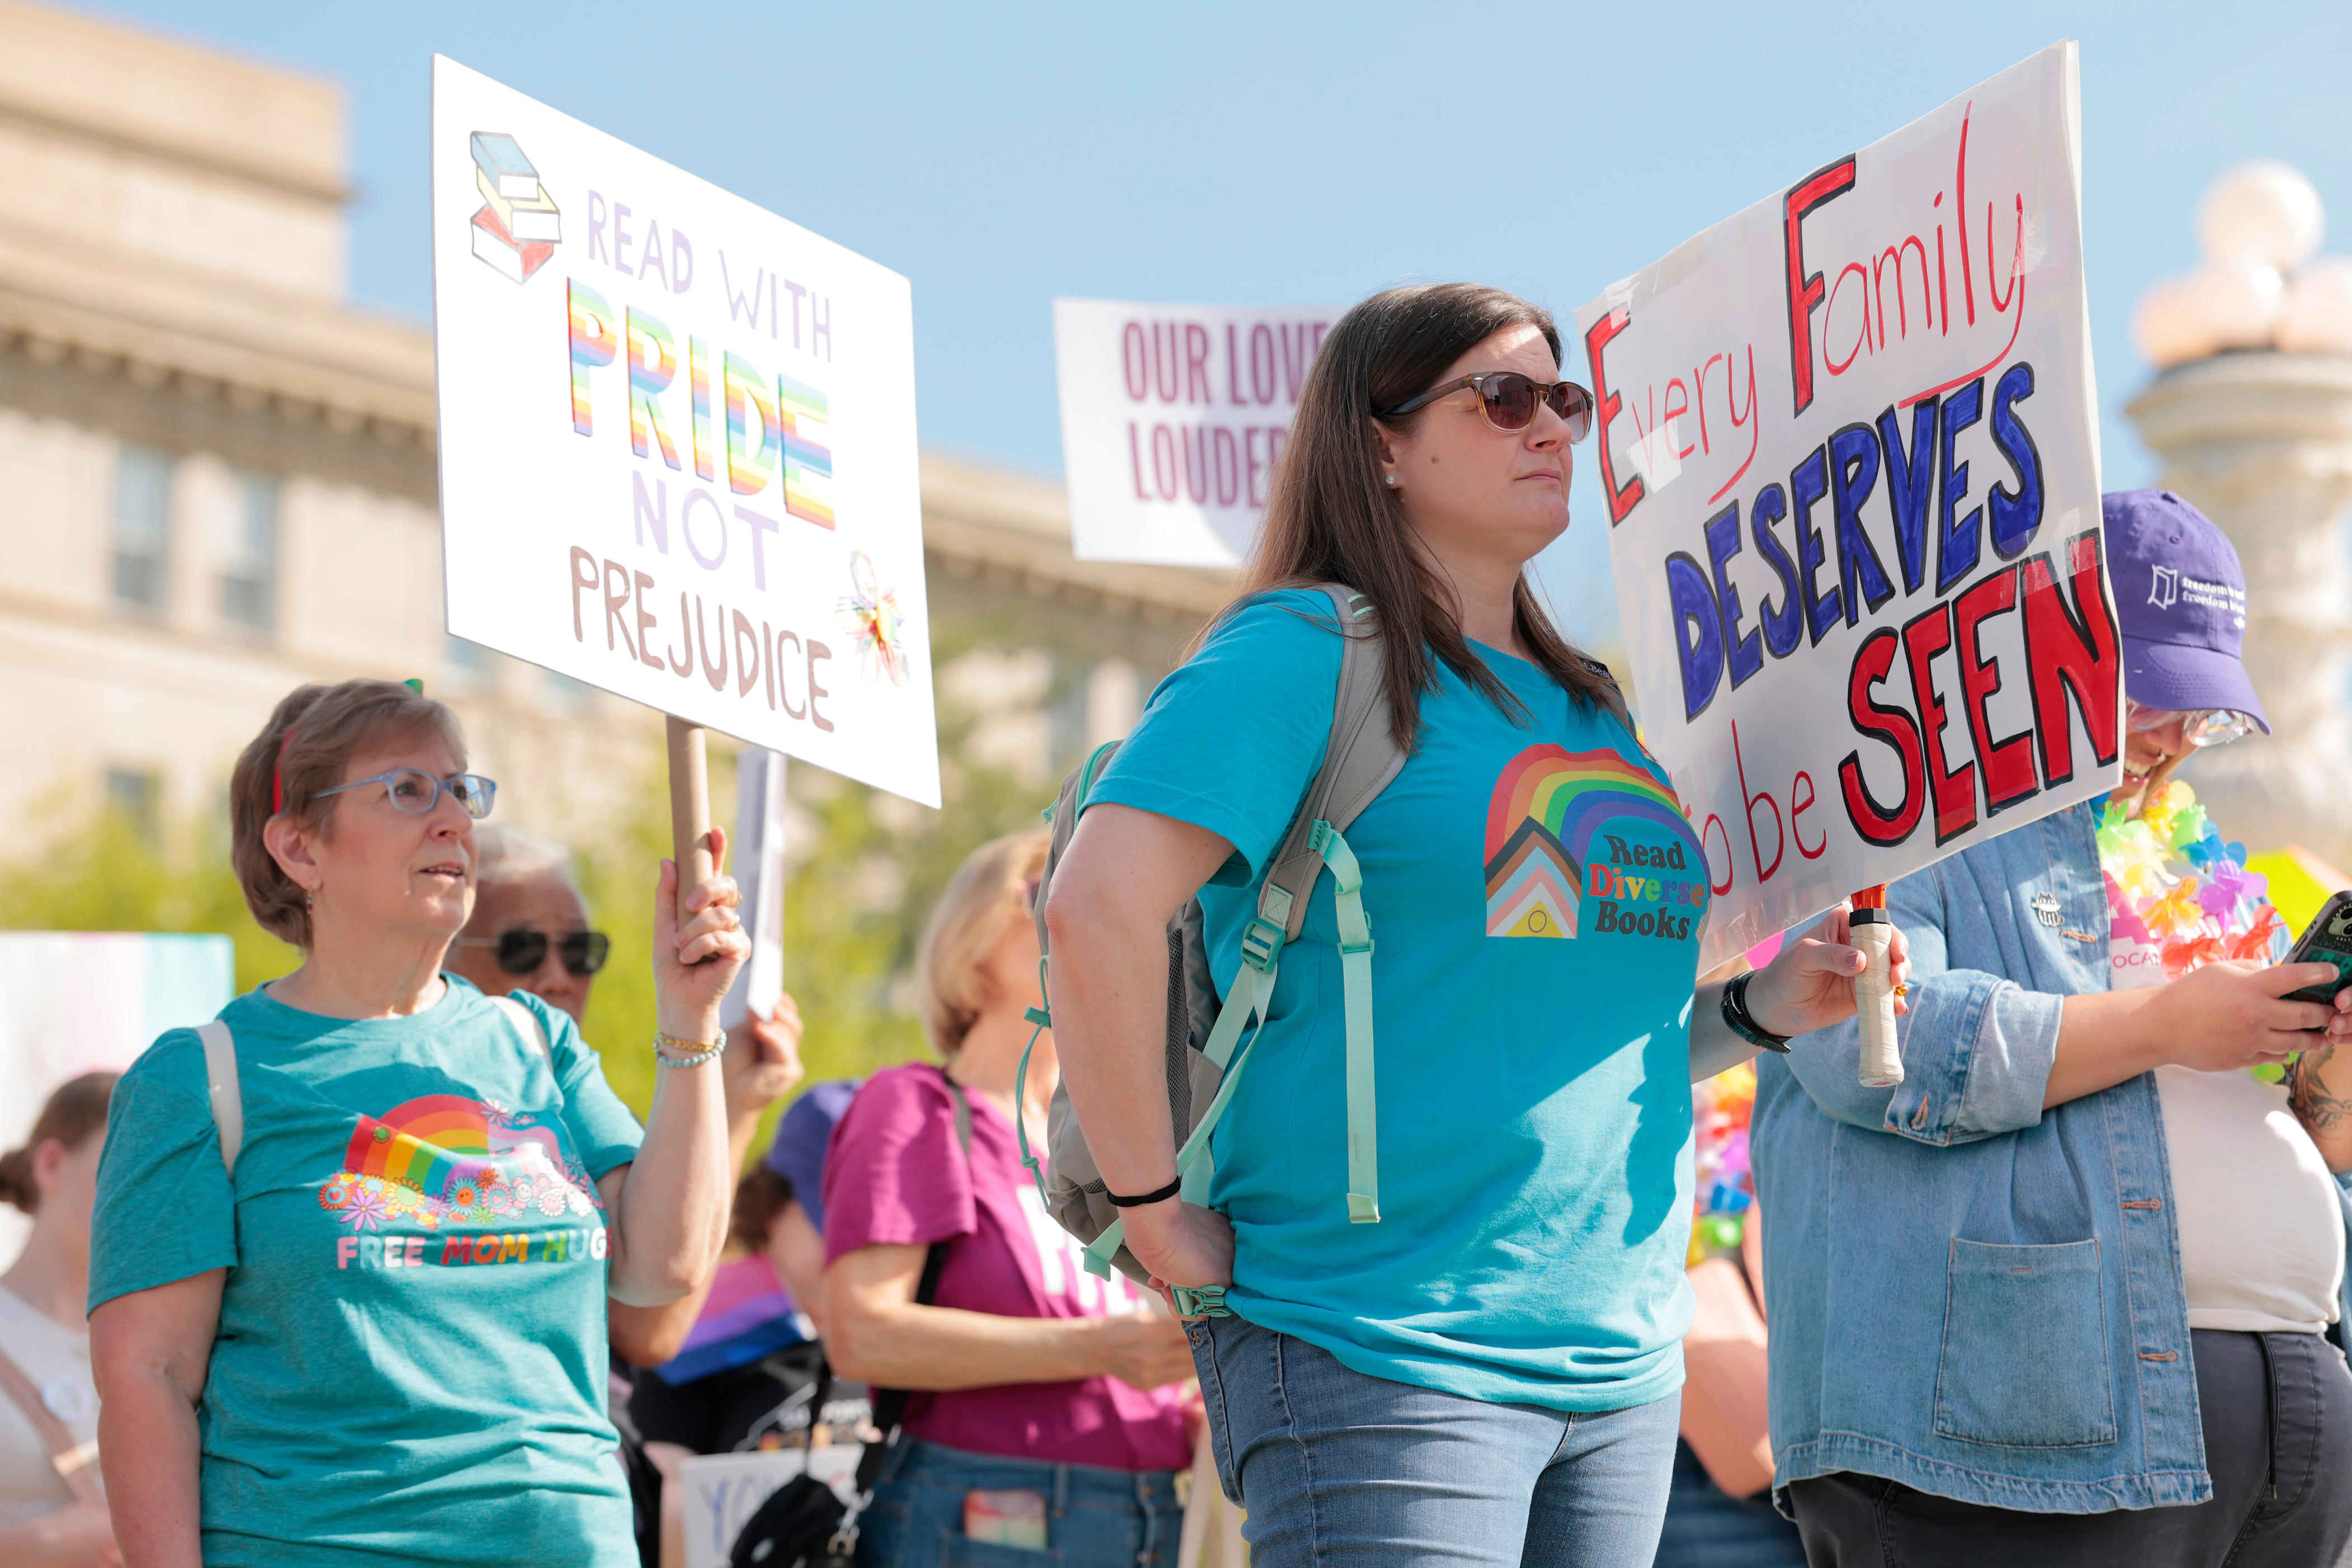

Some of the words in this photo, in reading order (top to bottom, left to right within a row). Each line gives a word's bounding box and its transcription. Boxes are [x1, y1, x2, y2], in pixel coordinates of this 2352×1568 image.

[587, 189, 693, 294] READ
[719, 249, 831, 363] WITH
[1586, 306, 1756, 527] Every
[1783, 100, 2025, 418] Family
[566, 276, 836, 531] PRIDE
[1122, 320, 1210, 404] OUR
[632, 469, 779, 592] NOT
[1666, 362, 2044, 724] DESERVES
[569, 546, 835, 733] PREJUDICE
[2182, 590, 2228, 610] freedom
[1732, 719, 1826, 883] be
[1838, 527, 2120, 848] SEEN
[1588, 863, 1704, 908] Diverse
[1603, 834, 1687, 870] Read
[1595, 900, 1690, 941] Books
[337, 1236, 426, 1269] FREE
[441, 1233, 530, 1265] MOM
